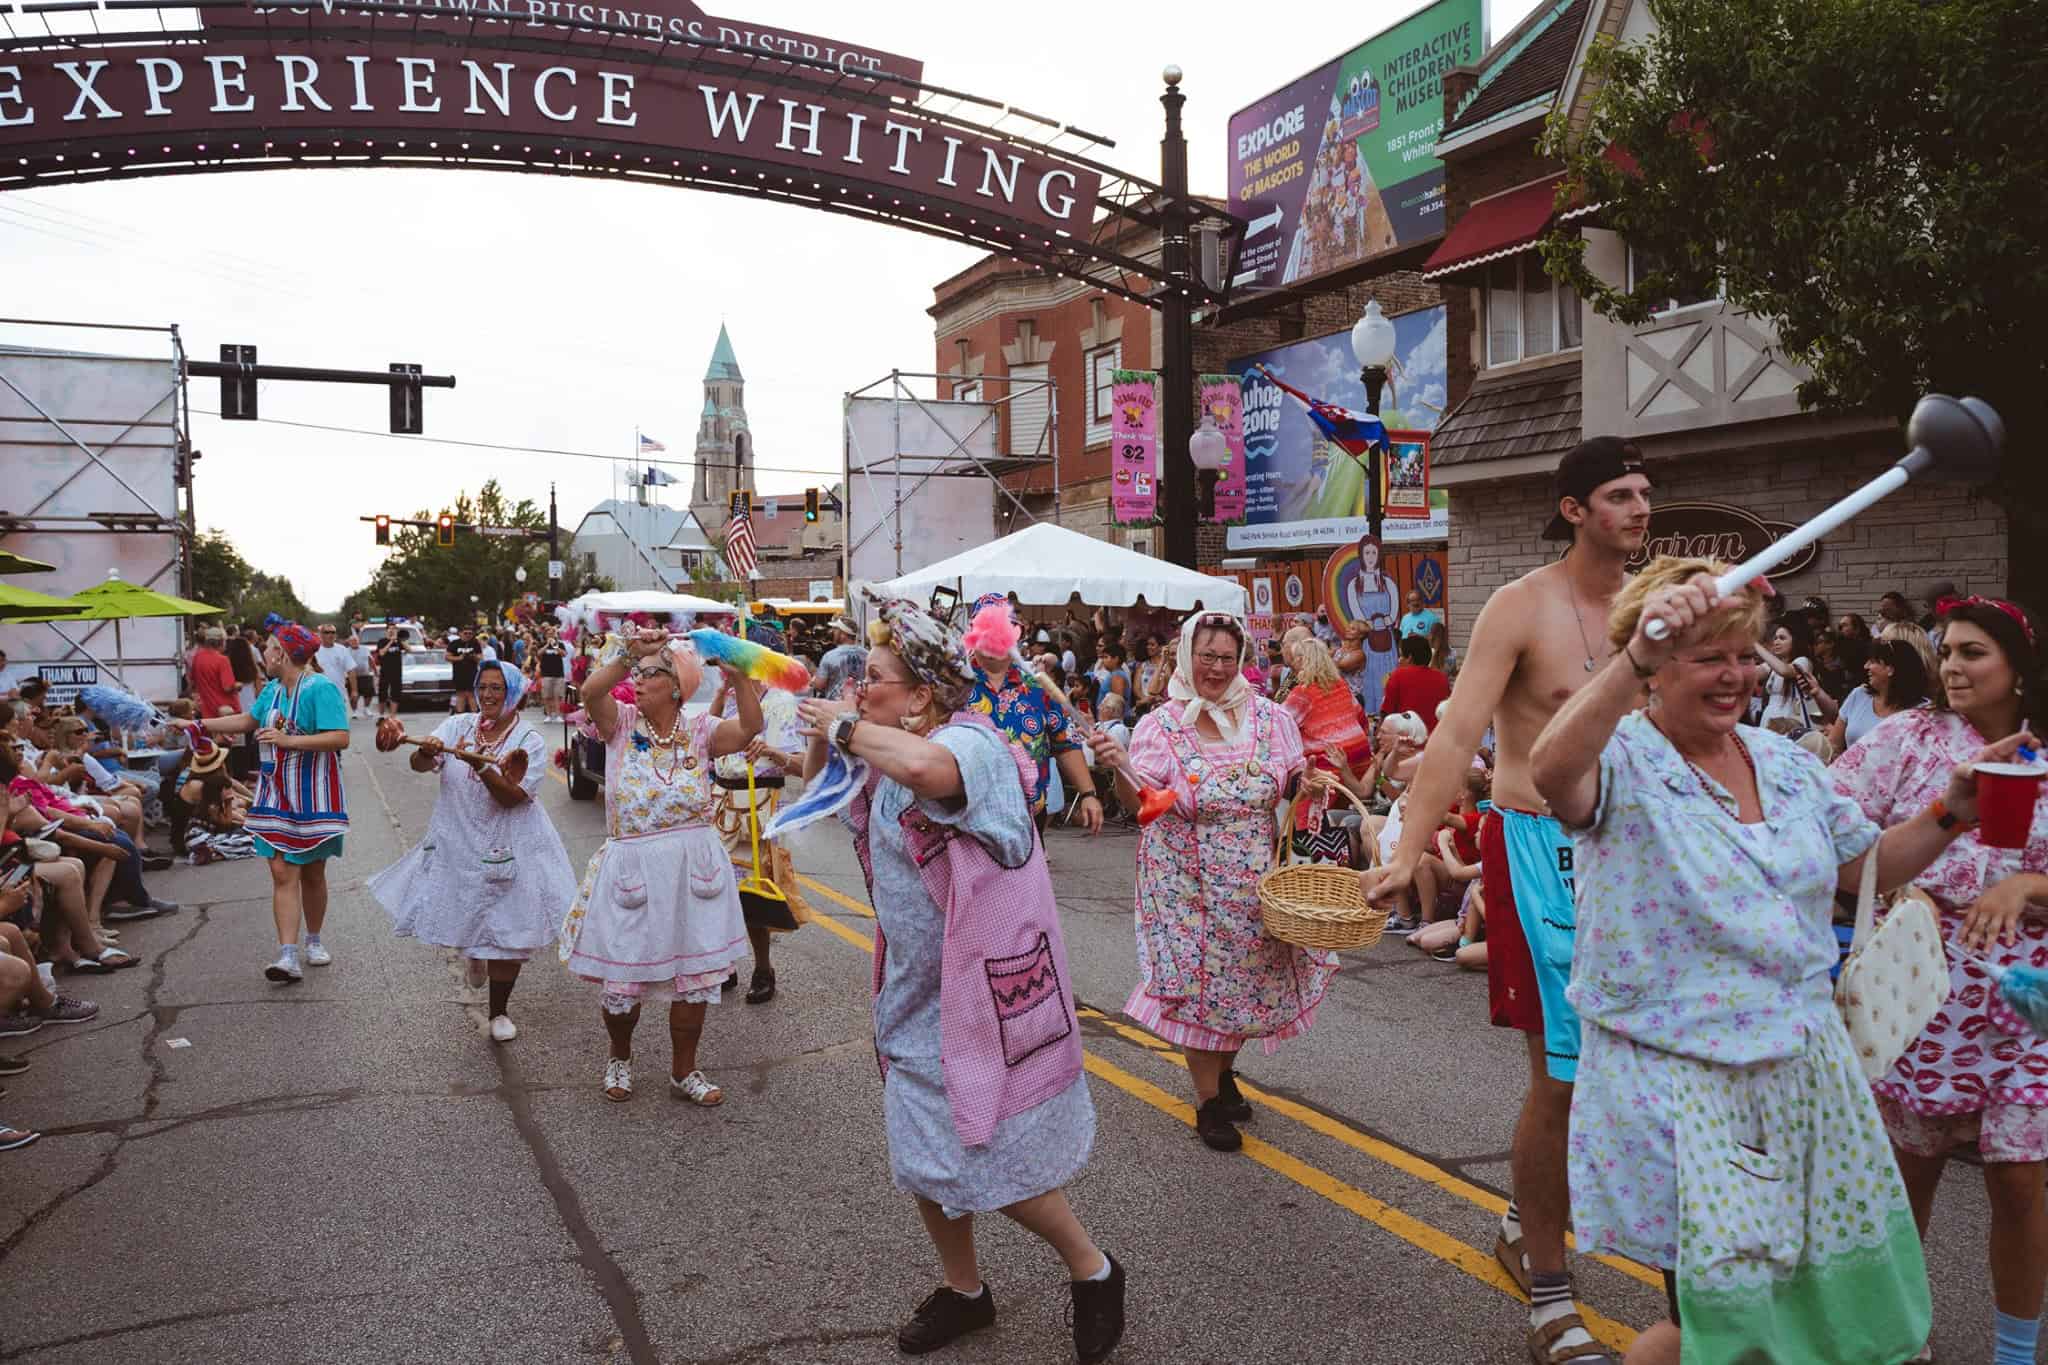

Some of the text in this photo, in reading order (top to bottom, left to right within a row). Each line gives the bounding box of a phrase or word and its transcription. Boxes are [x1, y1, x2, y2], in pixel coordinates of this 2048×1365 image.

[716, 26, 881, 82] DISTRICT
[1384, 21, 1471, 81] INTERACTIVE
[1388, 43, 1471, 97] CHILDREN'S
[1397, 79, 1444, 115] MUSEU
[0, 55, 1077, 220] EXPERIENCE WHITING
[1238, 104, 1305, 161] EXPLORE
[1402, 142, 1434, 163] Whitin
[1408, 123, 1435, 145] Front
[1244, 139, 1300, 179] THE WORLD
[1240, 160, 1304, 202] OF MASCOTS
[1242, 408, 1281, 437] zone
[1134, 445, 1145, 461] 2
[40, 667, 96, 682] THANK YOU
